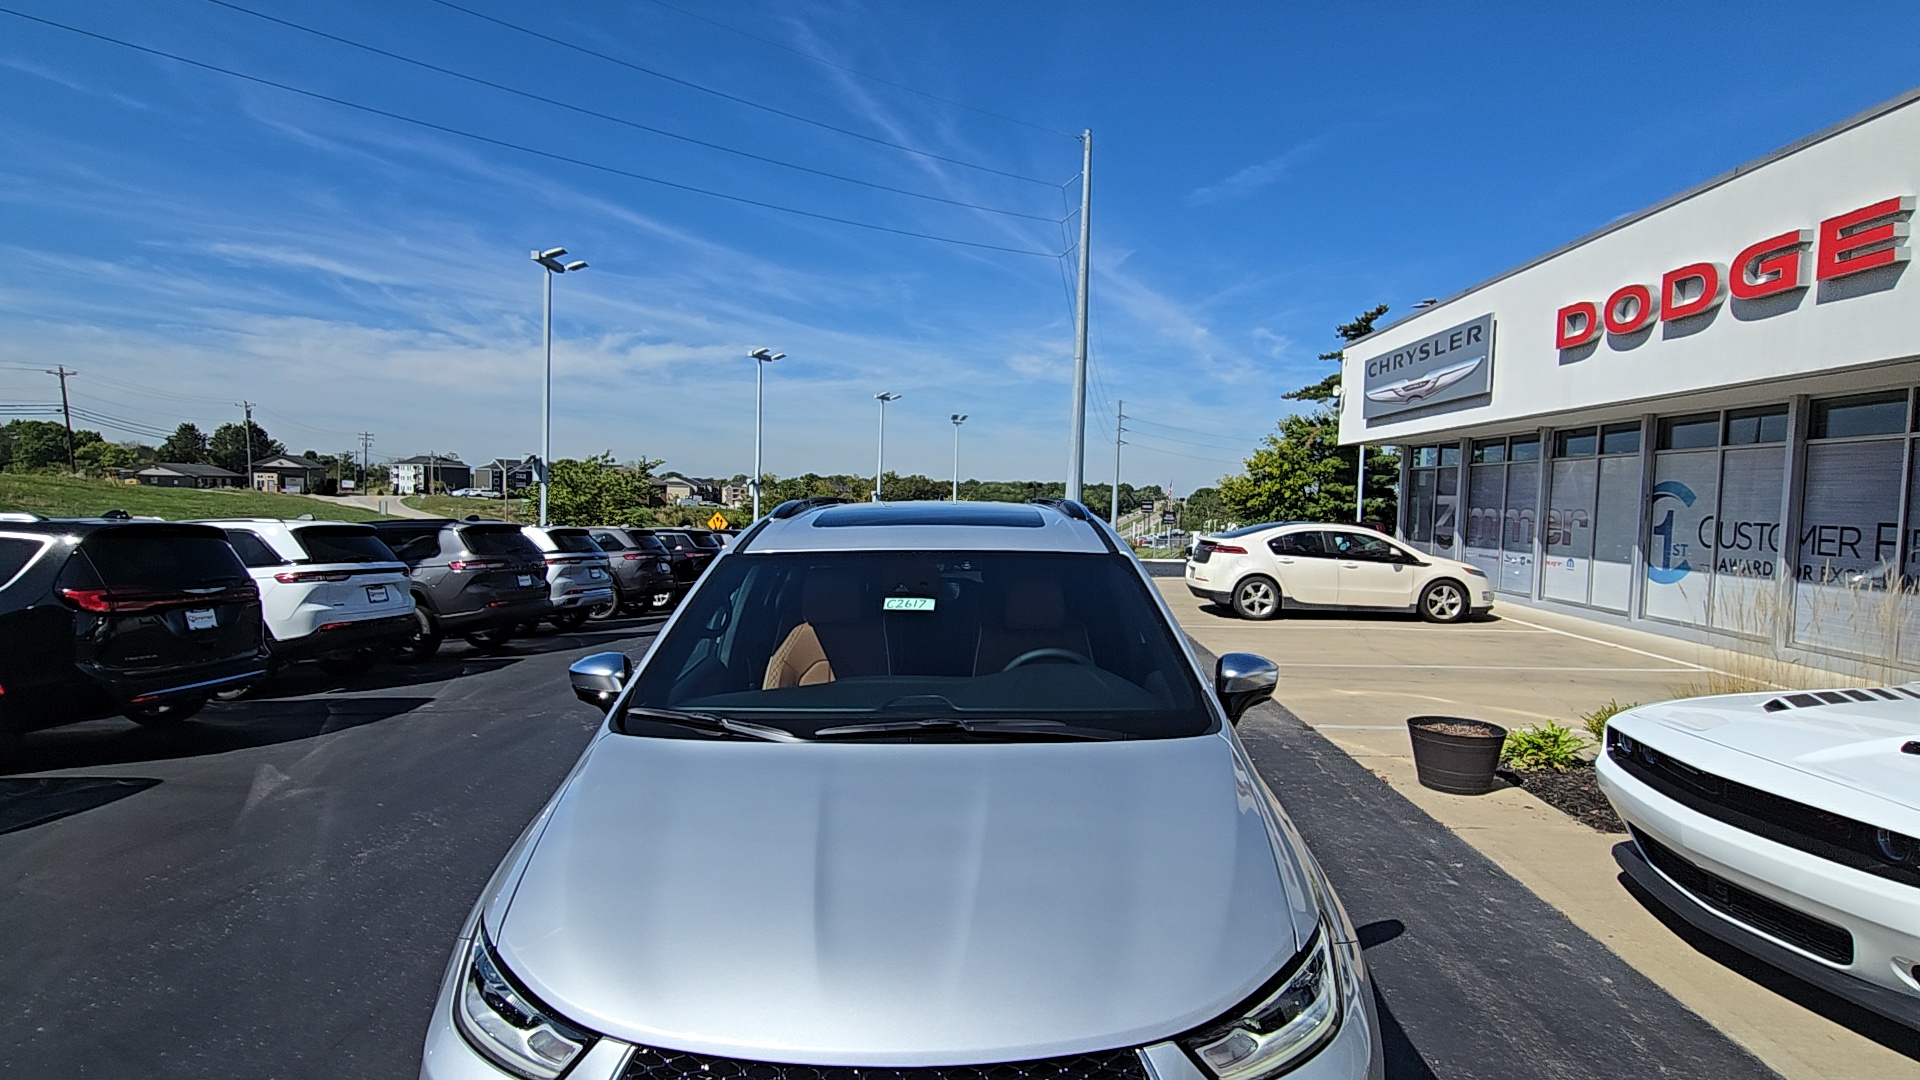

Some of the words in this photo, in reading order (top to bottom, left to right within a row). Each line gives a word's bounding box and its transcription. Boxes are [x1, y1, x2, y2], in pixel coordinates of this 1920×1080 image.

[1555, 195, 1904, 351] DODGE
[1367, 324, 1482, 378] CHRYSLER
[1434, 495, 1589, 546] Zmmer
[1718, 557, 1774, 577] AWARD
[886, 599, 927, 609] C2617
